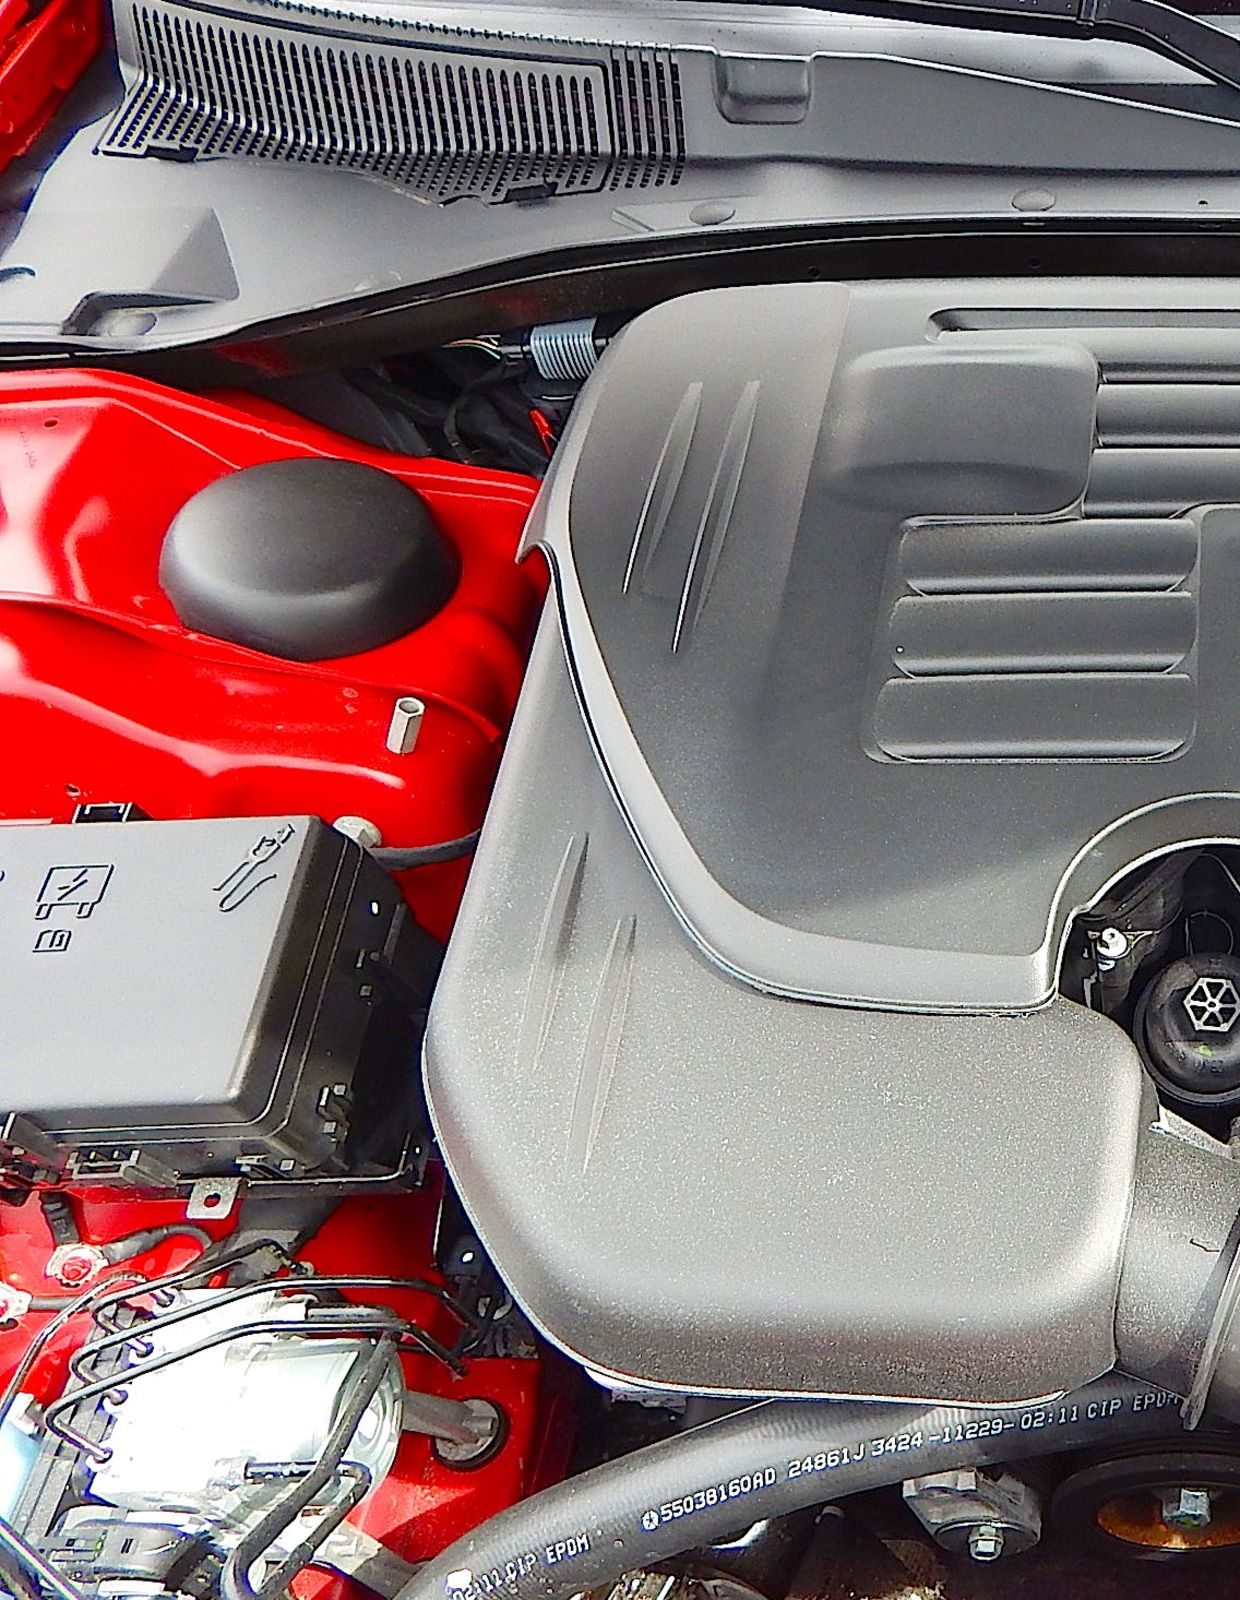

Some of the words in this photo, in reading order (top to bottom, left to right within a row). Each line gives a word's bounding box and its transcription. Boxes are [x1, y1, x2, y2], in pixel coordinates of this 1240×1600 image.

[660, 1466, 777, 1523] 55038160AD
[787, 1442, 866, 1479] 24861J
[1087, 1398, 1122, 1420] CIP
[546, 1533, 590, 1564] EPDM
